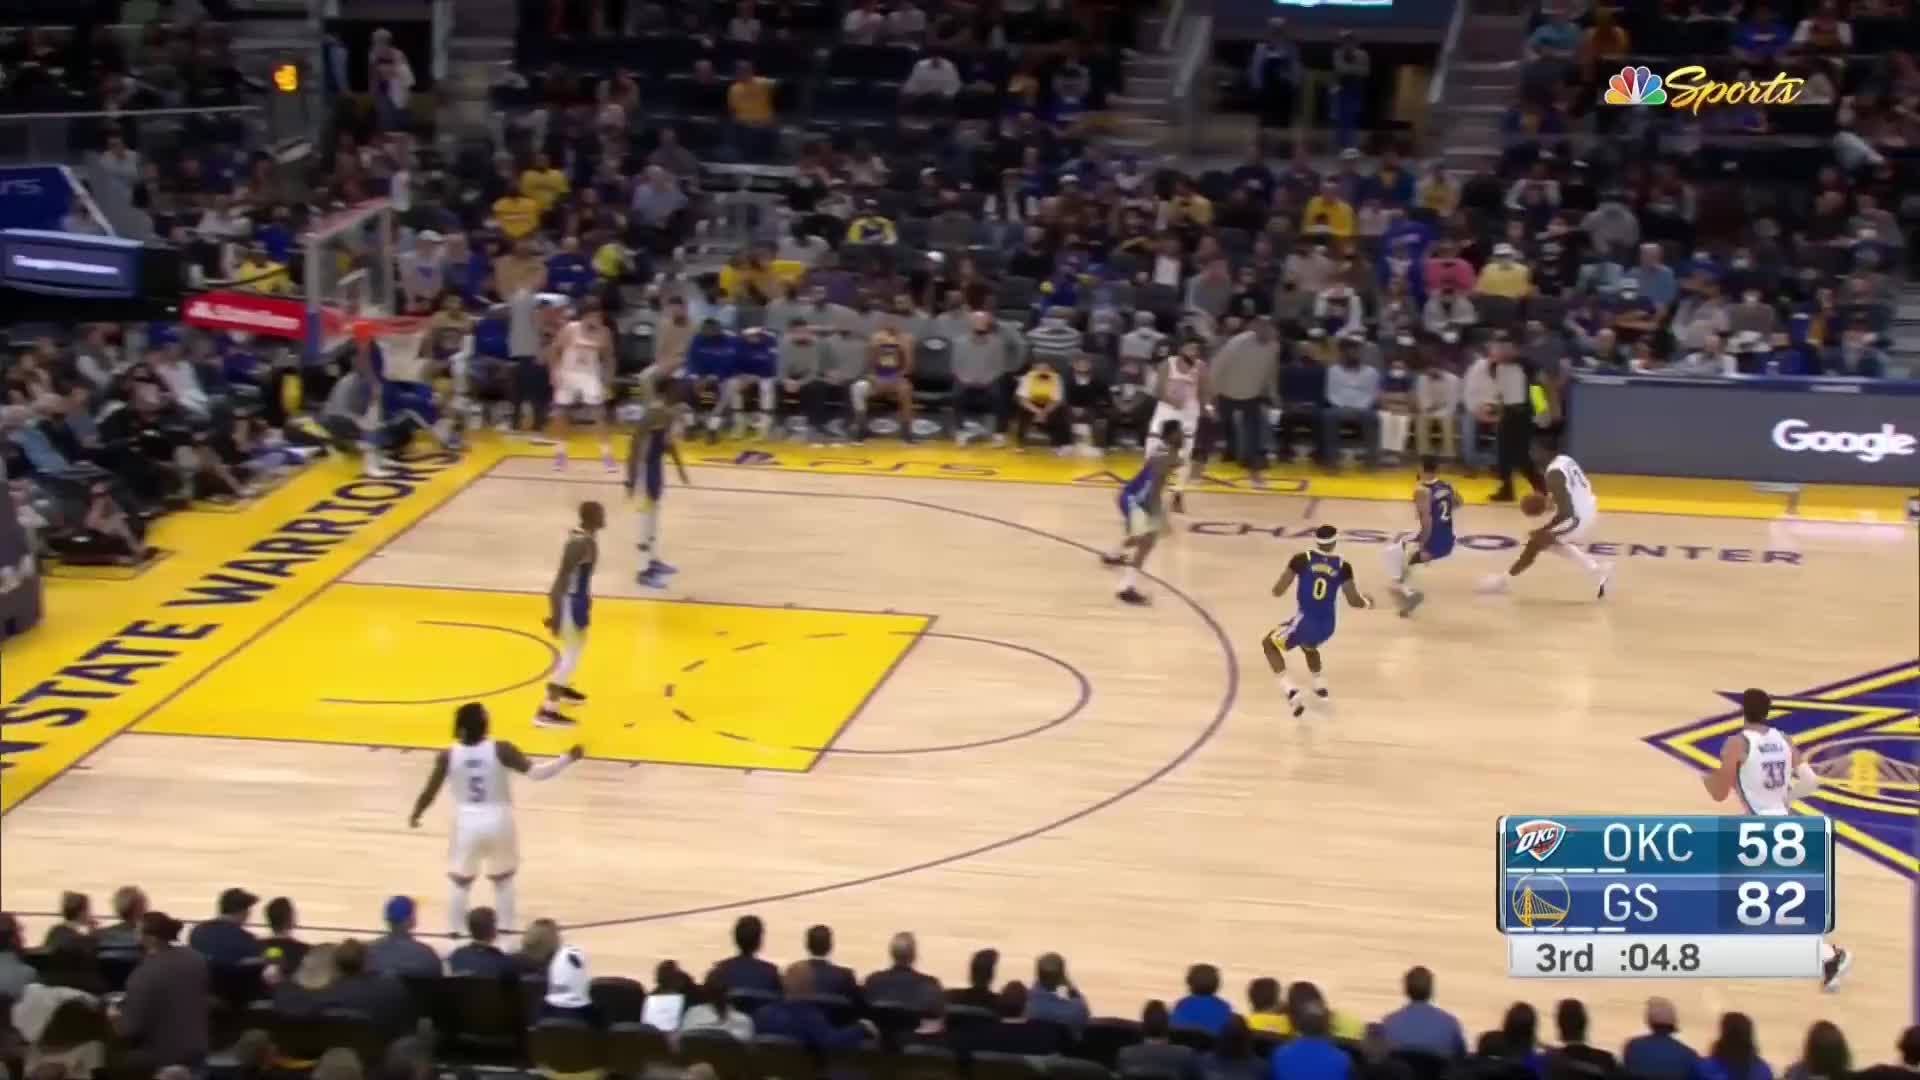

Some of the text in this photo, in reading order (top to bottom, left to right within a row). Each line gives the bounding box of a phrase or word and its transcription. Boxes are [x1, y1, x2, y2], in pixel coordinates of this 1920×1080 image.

[1772, 419, 1917, 462] Google
[1550, 541, 1803, 566] ENTER
[1313, 577, 1327, 600] 0
[0, 620, 222, 727] STATE
[469, 776, 486, 802] 5
